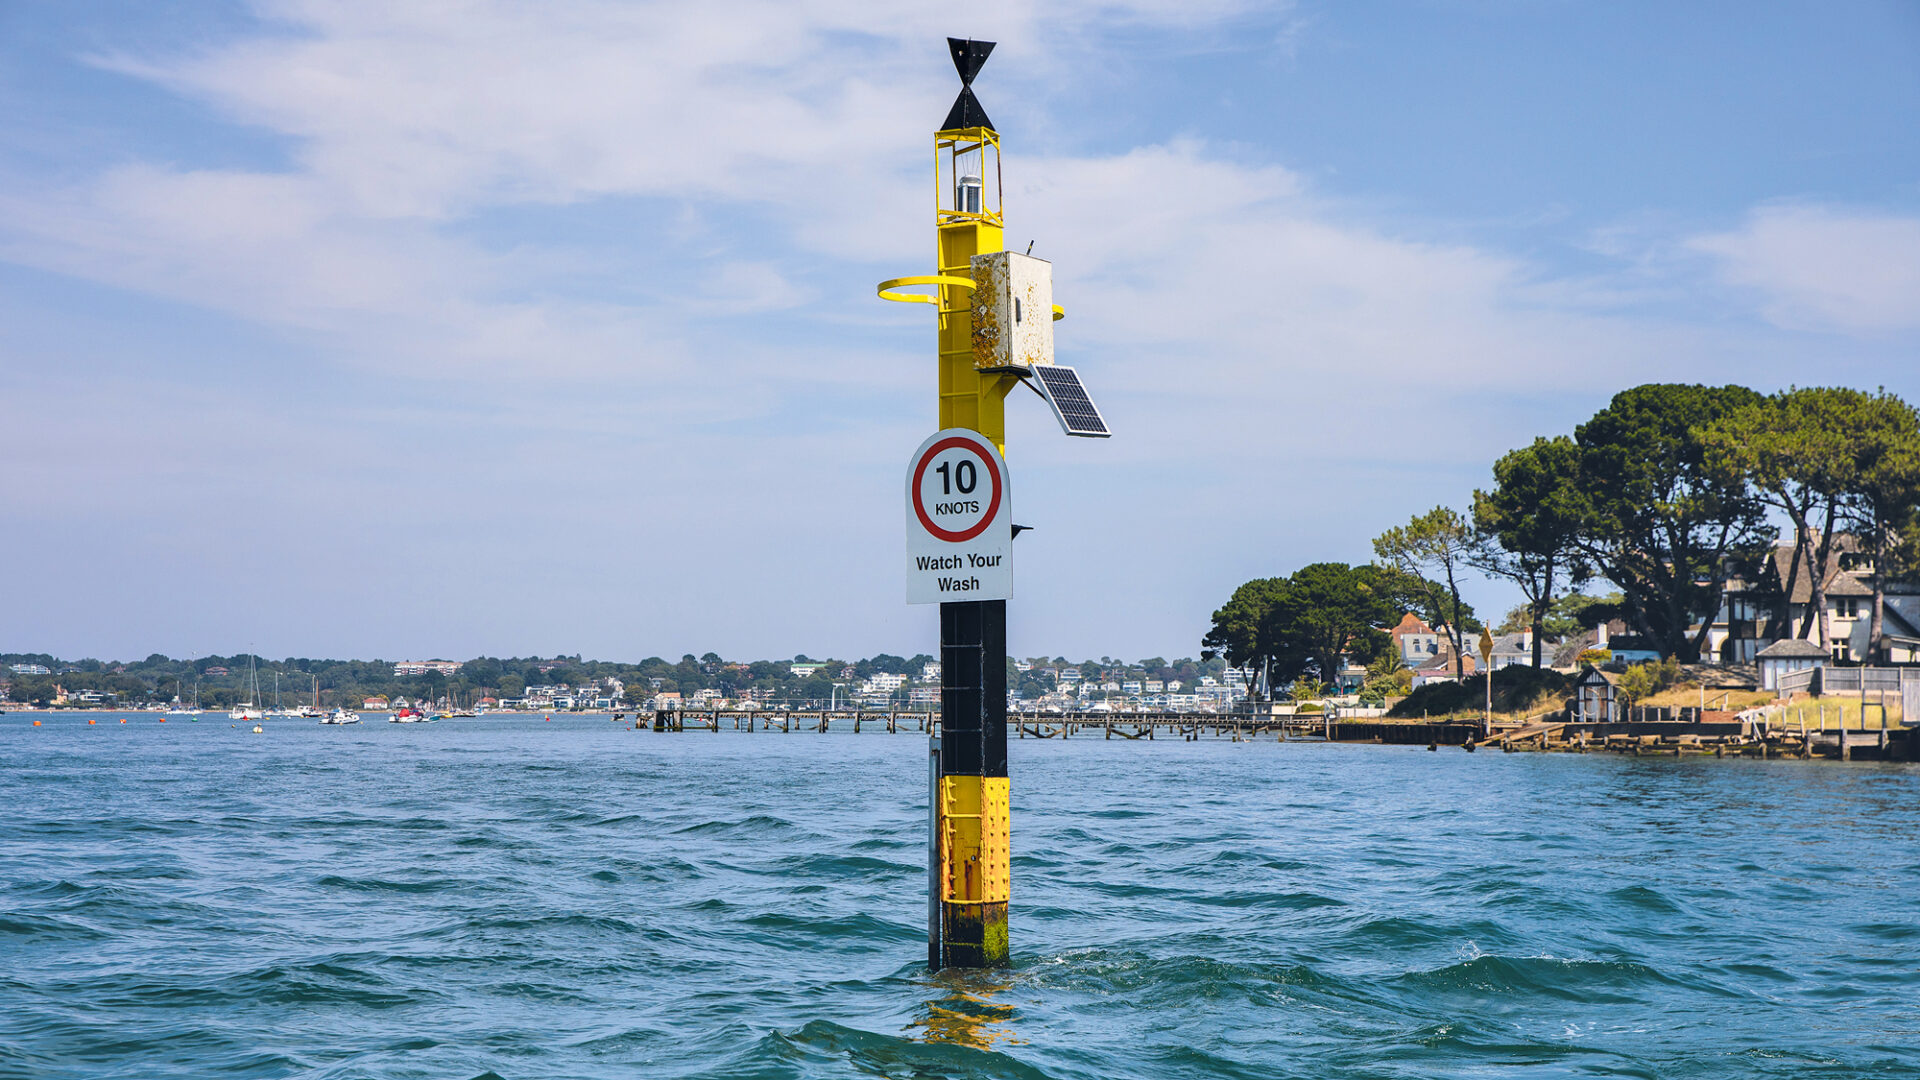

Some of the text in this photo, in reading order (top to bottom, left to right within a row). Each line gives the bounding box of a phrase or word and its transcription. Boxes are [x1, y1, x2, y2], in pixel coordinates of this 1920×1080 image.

[936, 460, 977, 495] 10
[935, 501, 980, 516] KNOTS
[916, 553, 1002, 571] Watch Your
[938, 576, 980, 592] Wash
